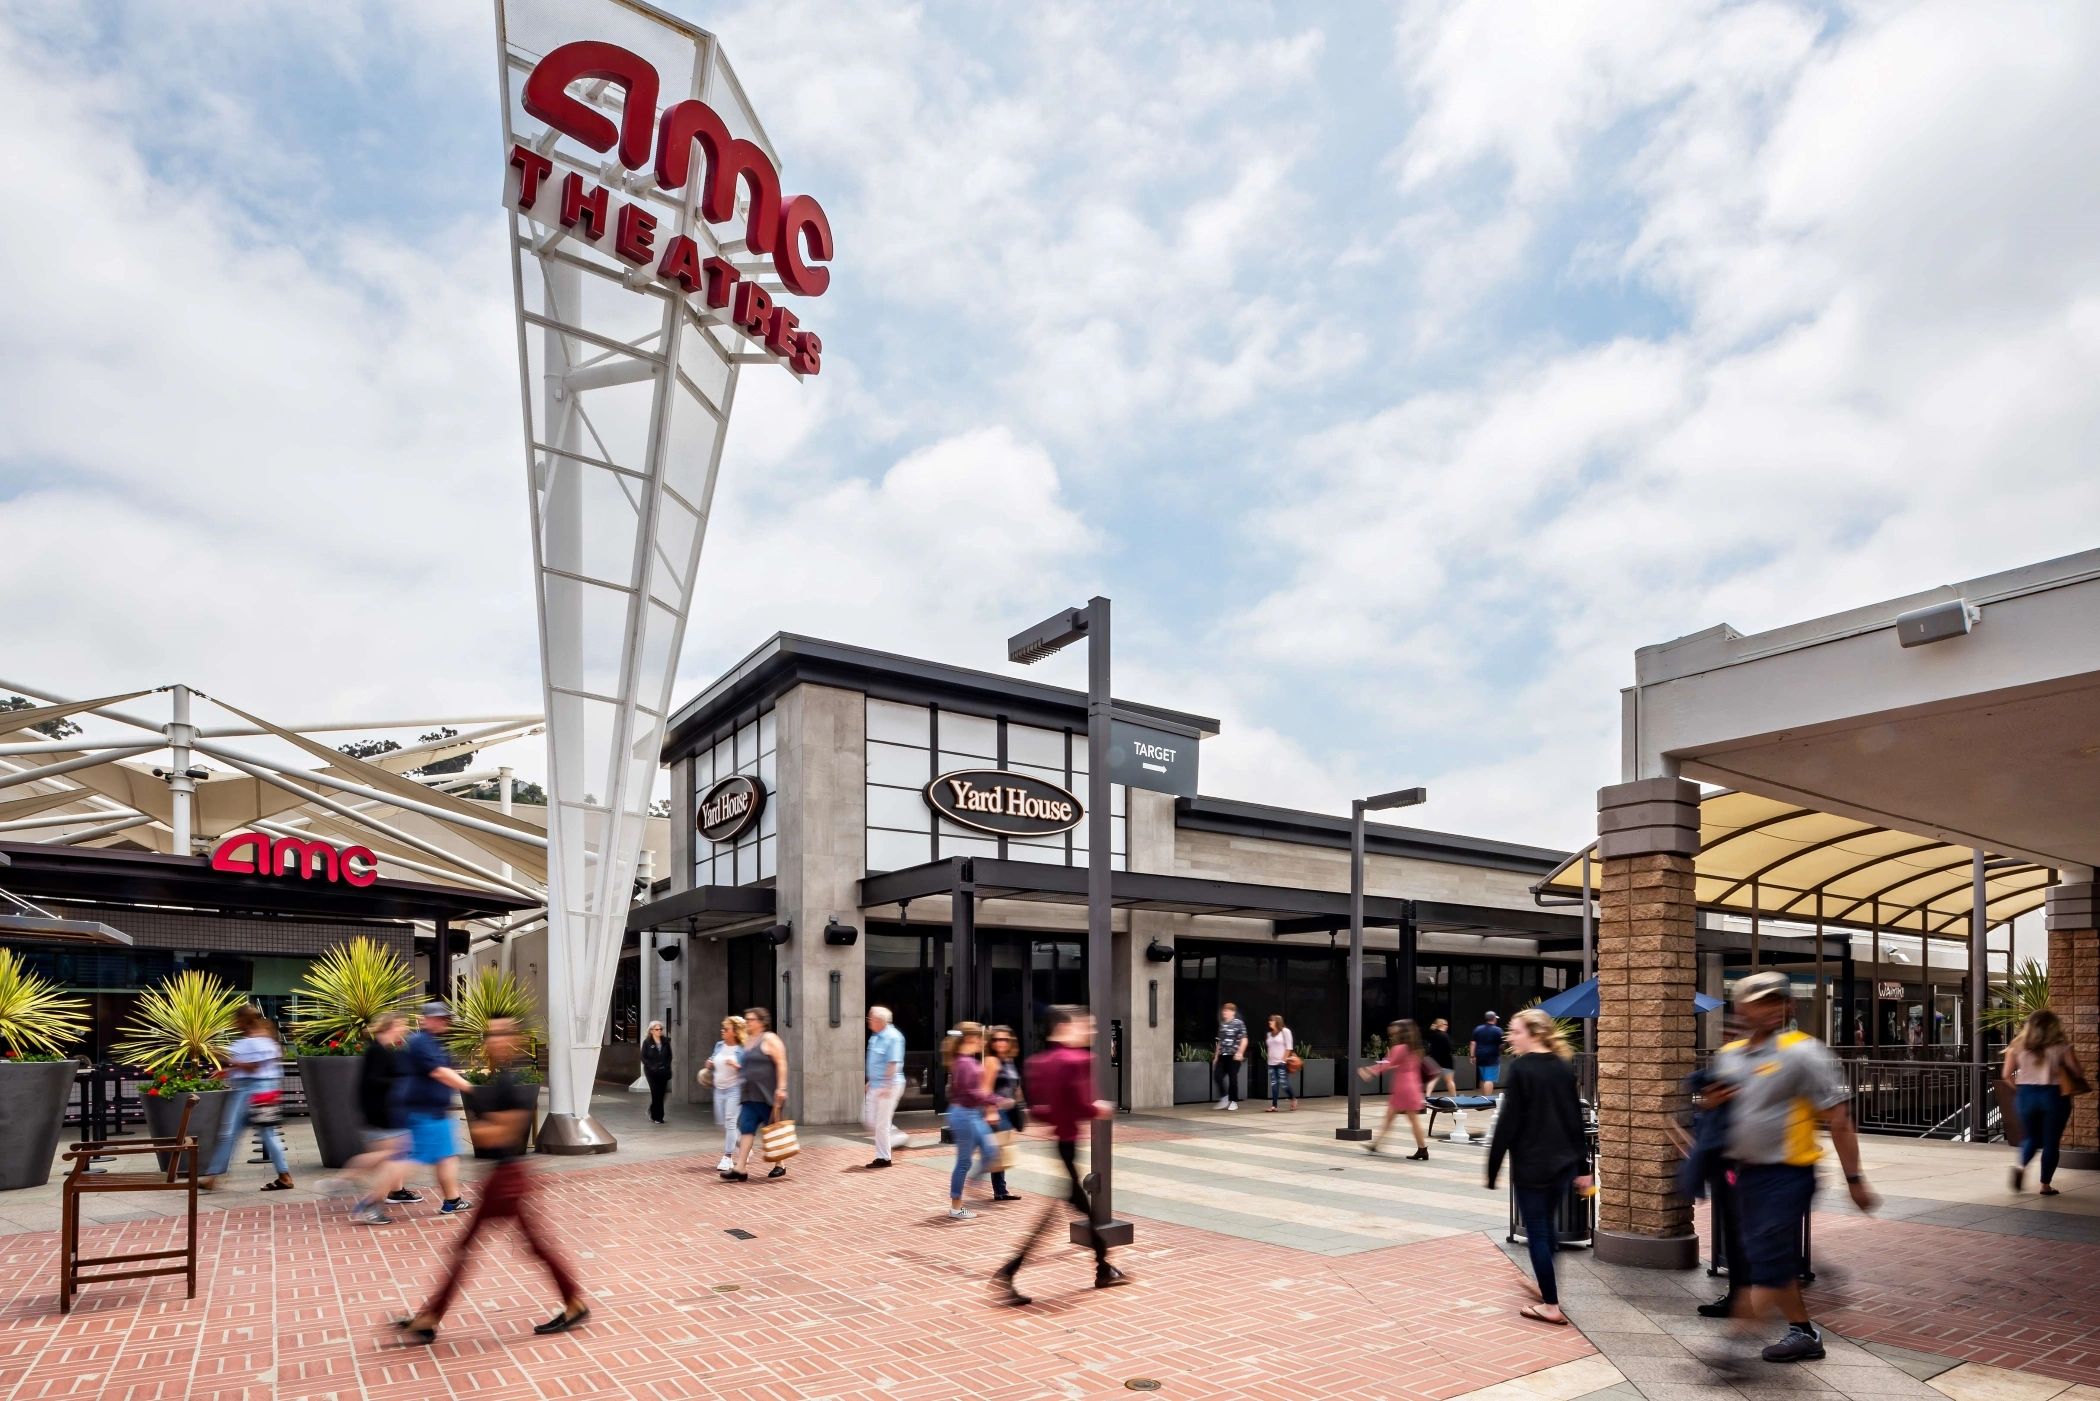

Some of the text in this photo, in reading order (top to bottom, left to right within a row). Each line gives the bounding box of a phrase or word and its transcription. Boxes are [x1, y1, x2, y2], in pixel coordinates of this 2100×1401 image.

[510, 144, 822, 375] THEATRES
[1133, 741, 1177, 762] TARGET
[702, 791, 748, 829] Yard House
[950, 779, 1072, 821] Yard House
